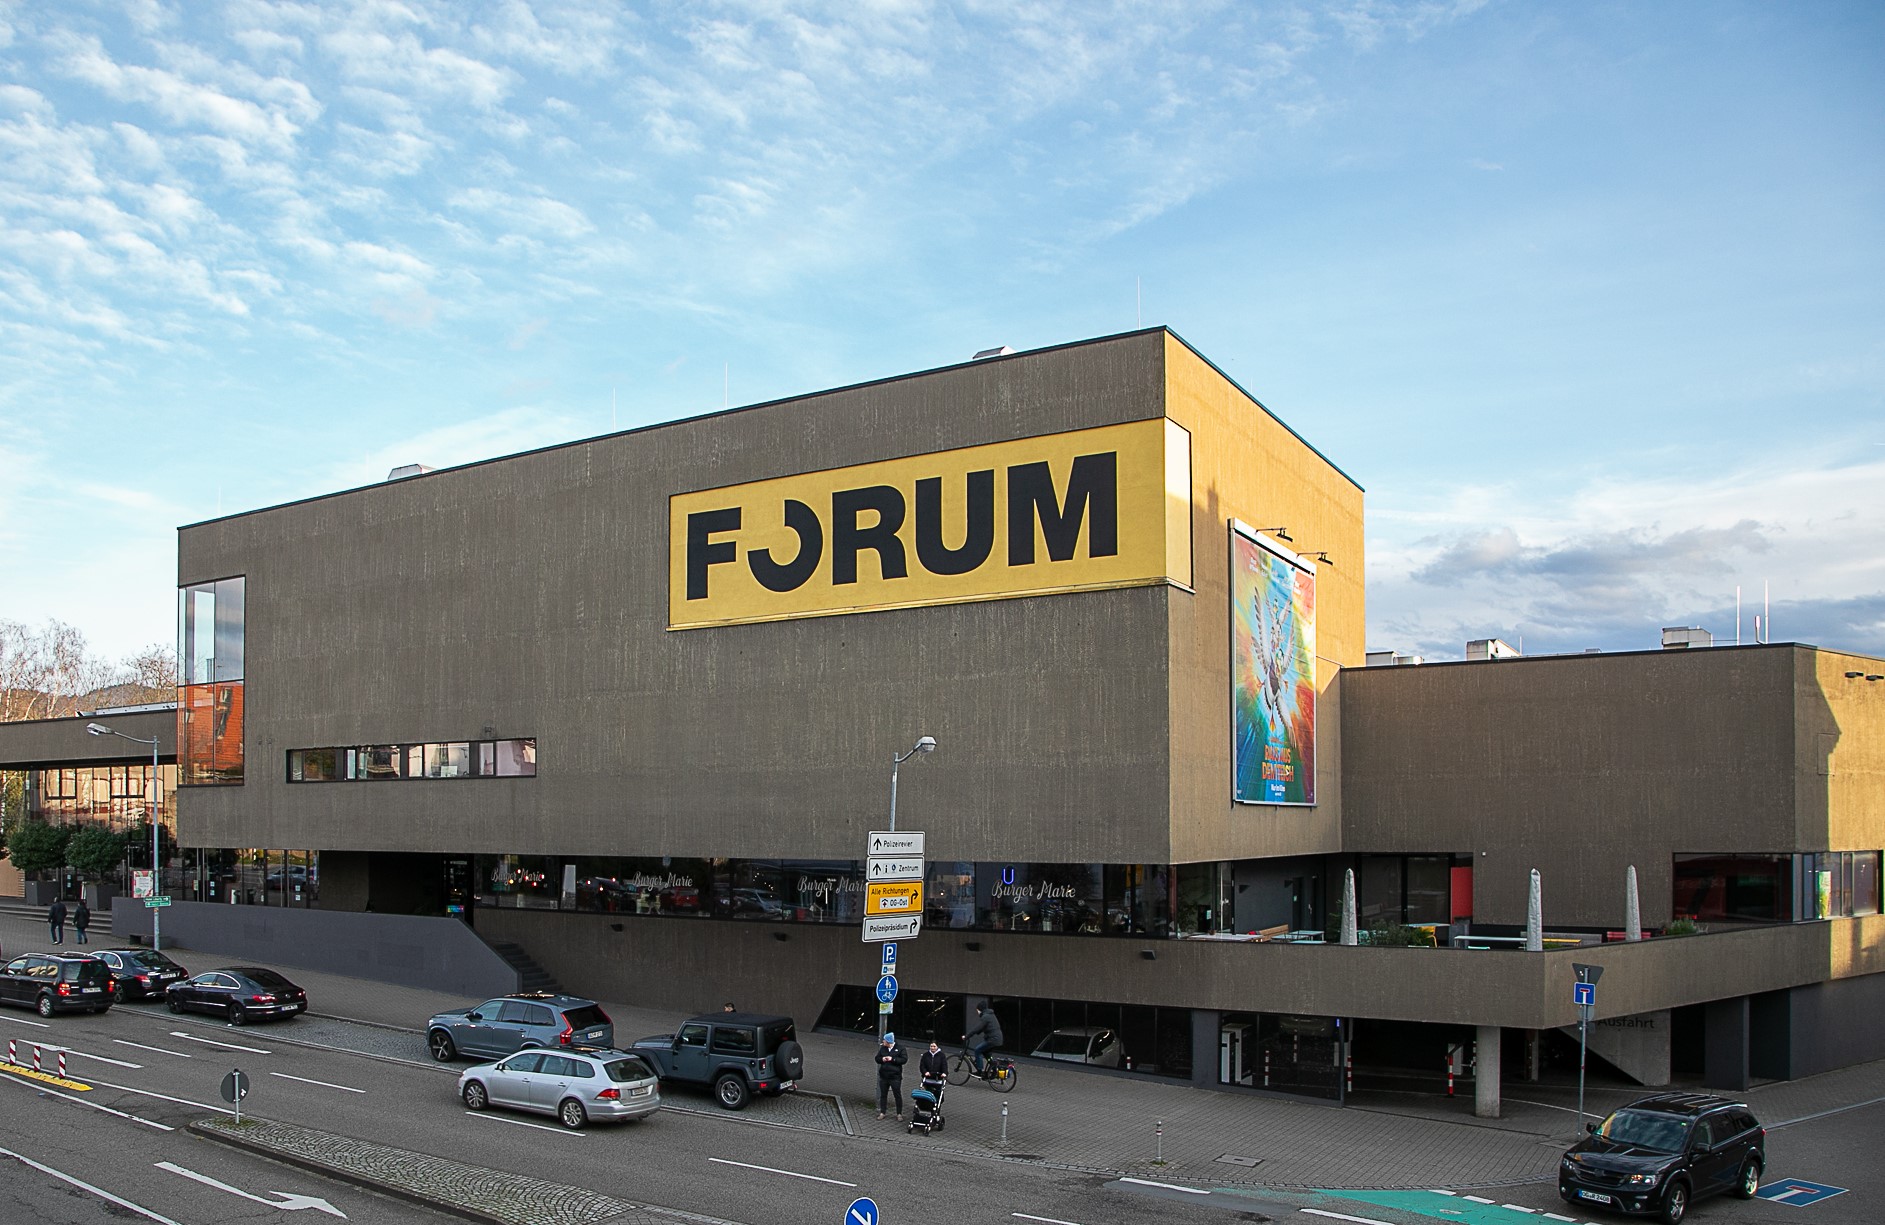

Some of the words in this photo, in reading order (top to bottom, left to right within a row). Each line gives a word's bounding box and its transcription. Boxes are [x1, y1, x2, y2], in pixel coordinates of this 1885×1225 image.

[686, 450, 1119, 601] FORUM
[883, 840, 913, 848] Polizeirevier
[898, 864, 919, 872] Zentrum
[632, 870, 663, 892] Burger
[664, 871, 693, 888] Marie
[797, 875, 833, 897] Burger
[882, 887, 910, 896] Richtungen
[991, 879, 1034, 904] Burger
[1036, 880, 1076, 900] Marie
[889, 898, 908, 907] OG-Ost
[869, 923, 909, 934] Polizeipräsidium
[886, 947, 893, 961] P
[1597, 1017, 1655, 1029] Ausfahrt
